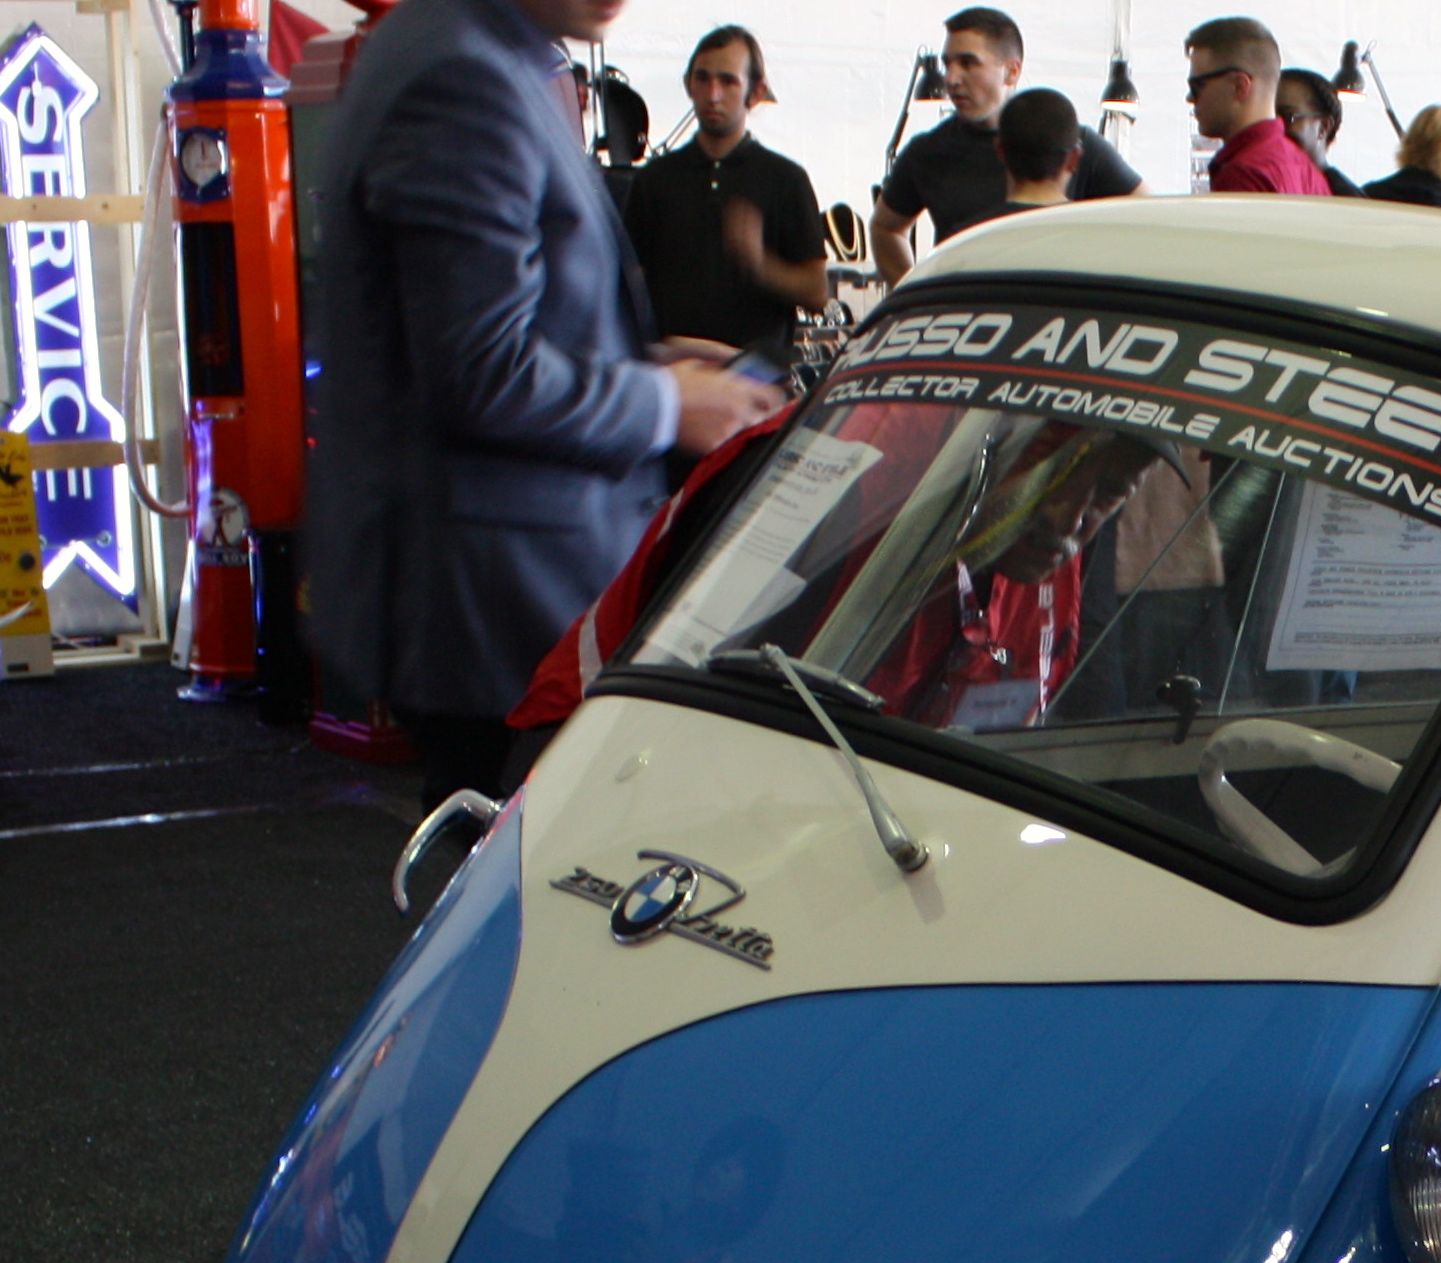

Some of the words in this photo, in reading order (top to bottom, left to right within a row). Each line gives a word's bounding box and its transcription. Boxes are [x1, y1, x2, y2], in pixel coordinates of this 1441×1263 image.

[16, 85, 92, 502] SERVICE
[1011, 317, 1179, 376] AND
[824, 375, 980, 404] COLLECTOR
[987, 381, 1221, 440] AUTOMOBILE
